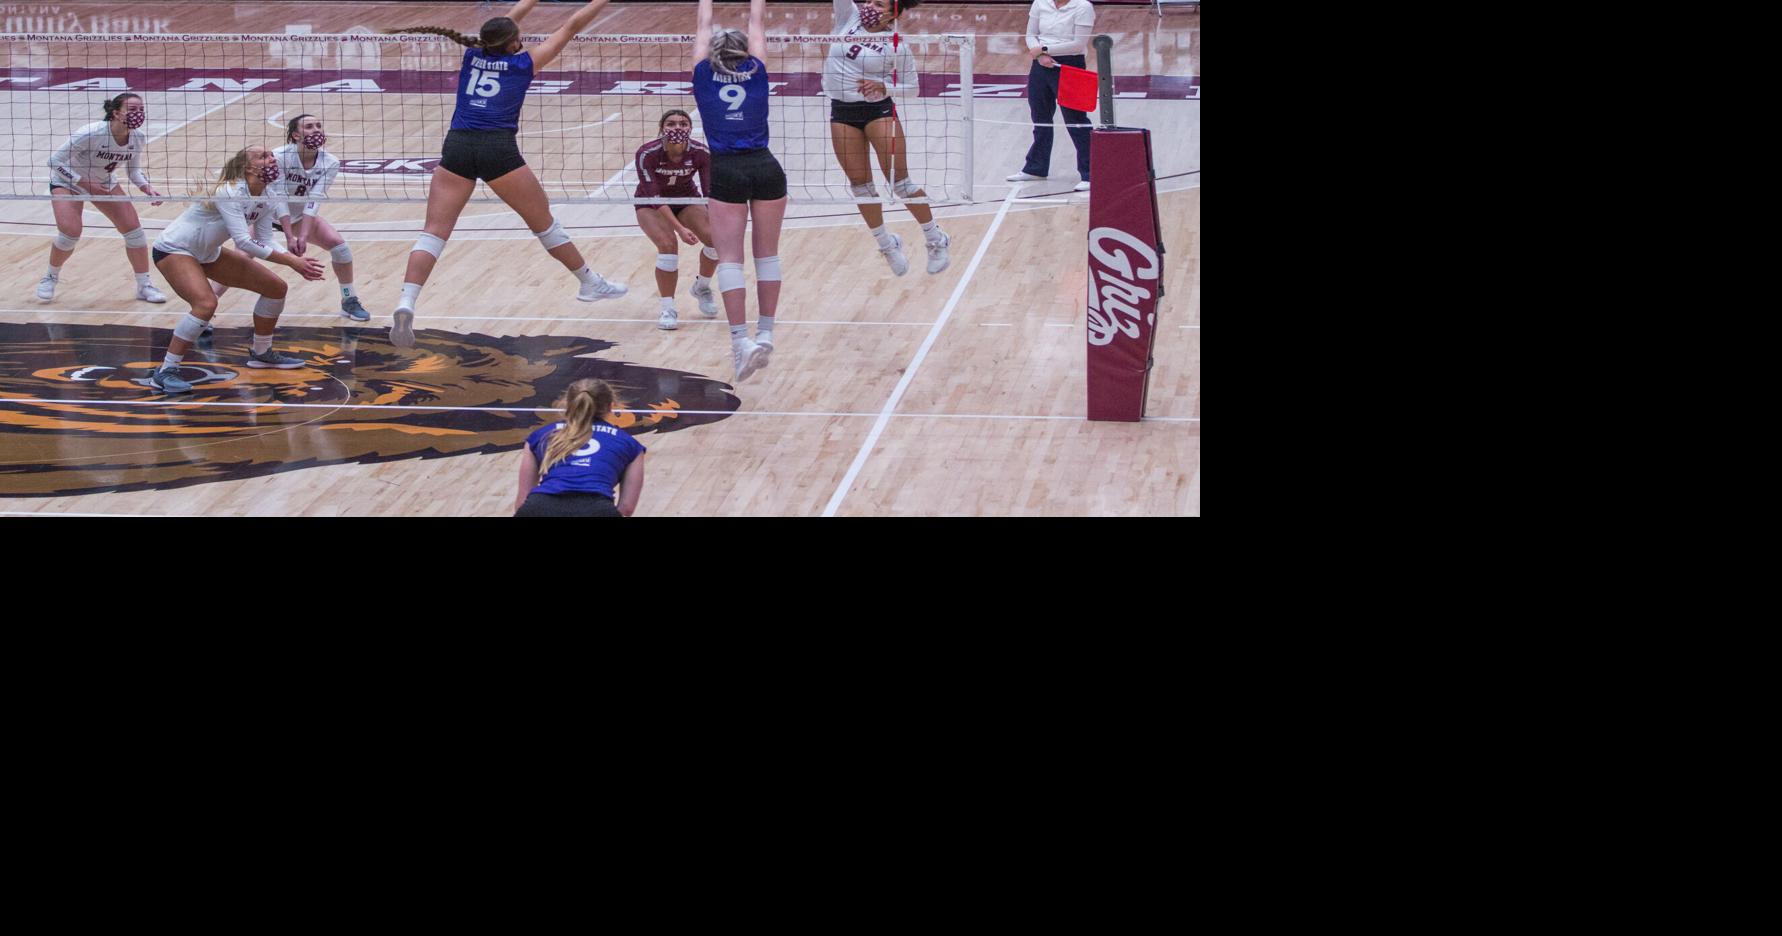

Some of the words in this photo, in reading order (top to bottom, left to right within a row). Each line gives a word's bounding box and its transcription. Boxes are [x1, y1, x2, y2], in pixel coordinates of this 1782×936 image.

[75, 34, 122, 42] GRIZZLIES
[134, 34, 179, 42] MONTANA
[182, 34, 230, 42] GRIZZLIES
[241, 34, 288, 42] MONTANA
[290, 34, 339, 42] GRIZZLIES
[620, 35, 669, 43] GRIZZLIES
[846, 44, 862, 60] 9
[466, 67, 501, 97] 15
[719, 84, 747, 111] 9
[104, 161, 118, 173] 4
